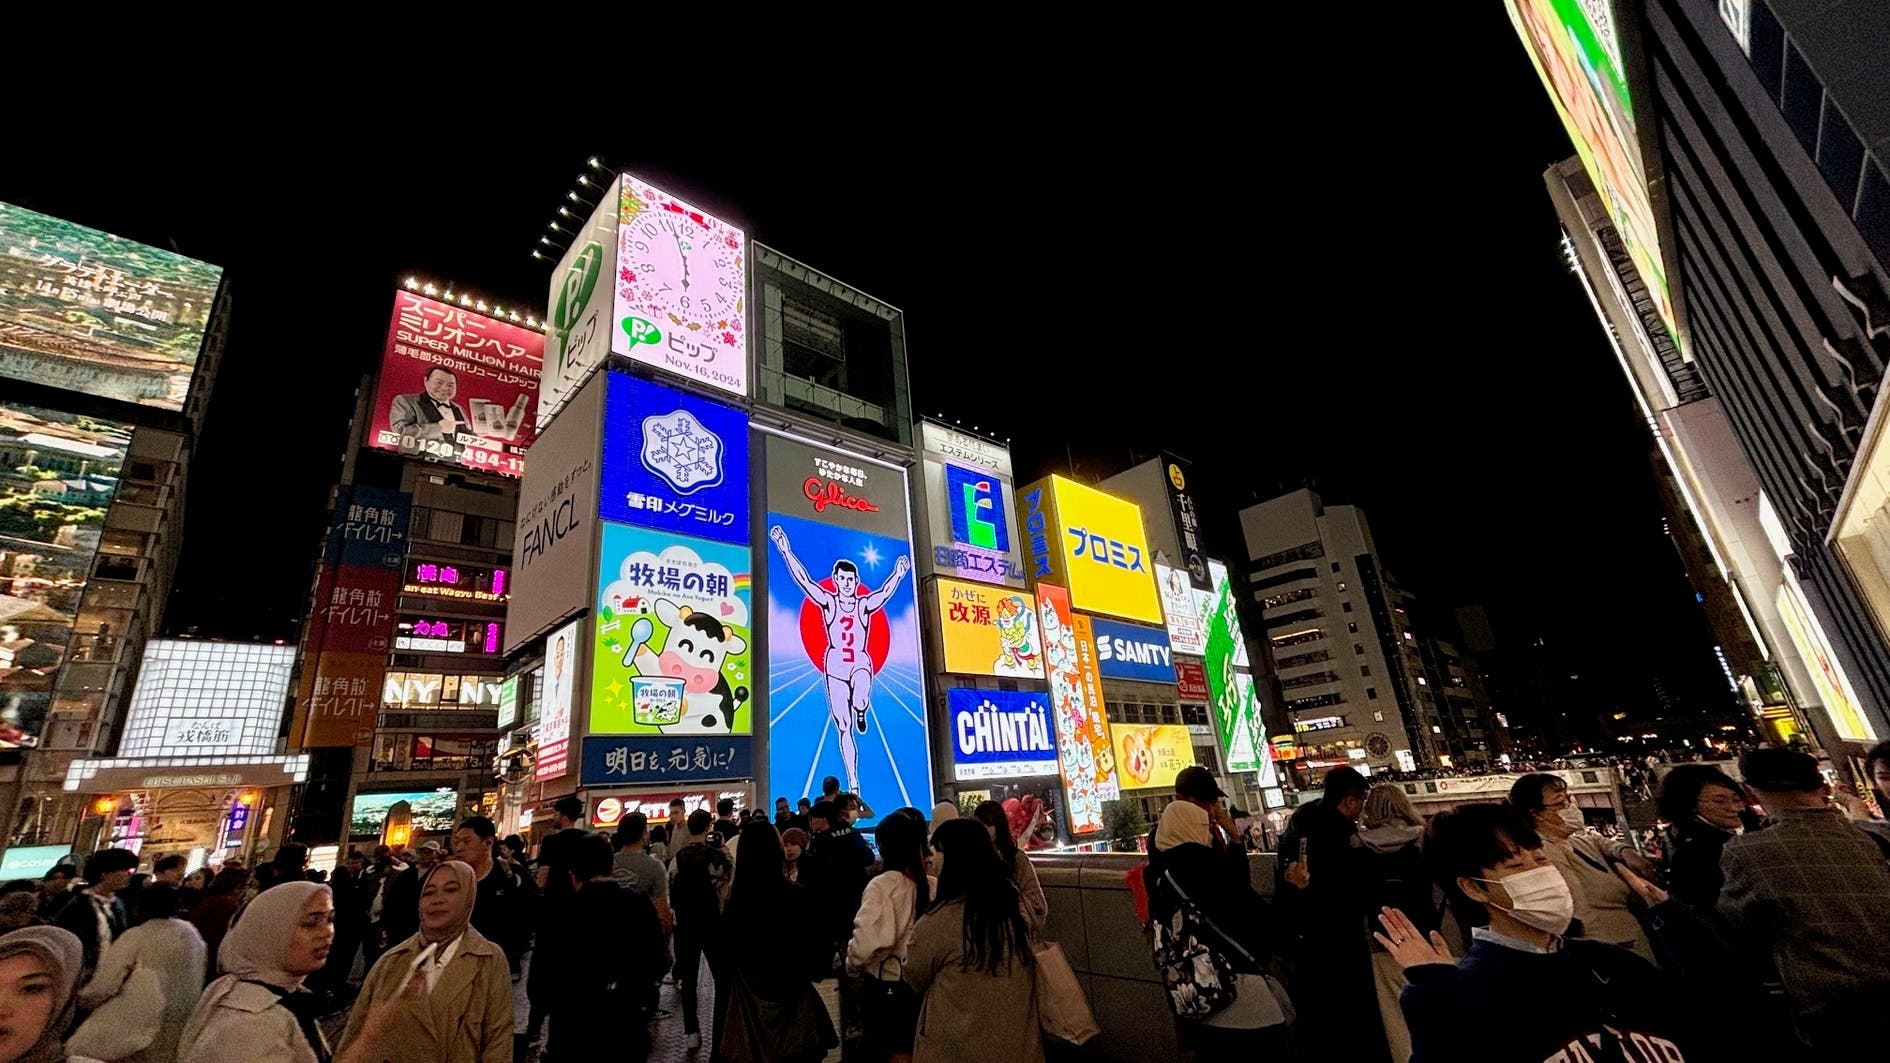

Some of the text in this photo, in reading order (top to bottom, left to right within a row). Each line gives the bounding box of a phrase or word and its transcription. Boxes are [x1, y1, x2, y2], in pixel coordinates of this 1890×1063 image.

[640, 222, 658, 240] 10
[679, 223, 694, 239] 12
[634, 240, 649, 254] 9
[640, 263, 655, 273] 8
[713, 258, 726, 268] 2
[658, 282, 672, 292] 7
[714, 291, 727, 304] 4
[401, 294, 487, 330] スーパー
[679, 295, 690, 309] 6
[700, 298, 711, 312] 5
[399, 312, 544, 362] ミリオンヘアー
[566, 309, 599, 369] ピップ
[668, 331, 718, 362] ピップ
[396, 330, 542, 379] SUPER MILLION HAIR
[459, 435, 488, 446] ルアン
[803, 476, 879, 513] Glico
[348, 504, 397, 526] 龍角散
[626, 491, 735, 526] 雪印メグミルク
[520, 492, 579, 571] FANCL
[1024, 488, 1052, 578] プロミス
[1068, 527, 1146, 574] プロミス
[629, 562, 728, 598] 牧場の朝
[331, 586, 384, 608] 龍角散
[420, 585, 438, 595] eat
[440, 588, 473, 598] Wagyu
[951, 587, 986, 604] かぜに
[948, 601, 992, 626] 改源
[839, 614, 855, 663] グリコ
[1113, 637, 1170, 667] SAMTY
[314, 676, 371, 696] 龍角散
[640, 688, 676, 698] 牧場の朝
[957, 699, 1053, 755] CHINTAI
